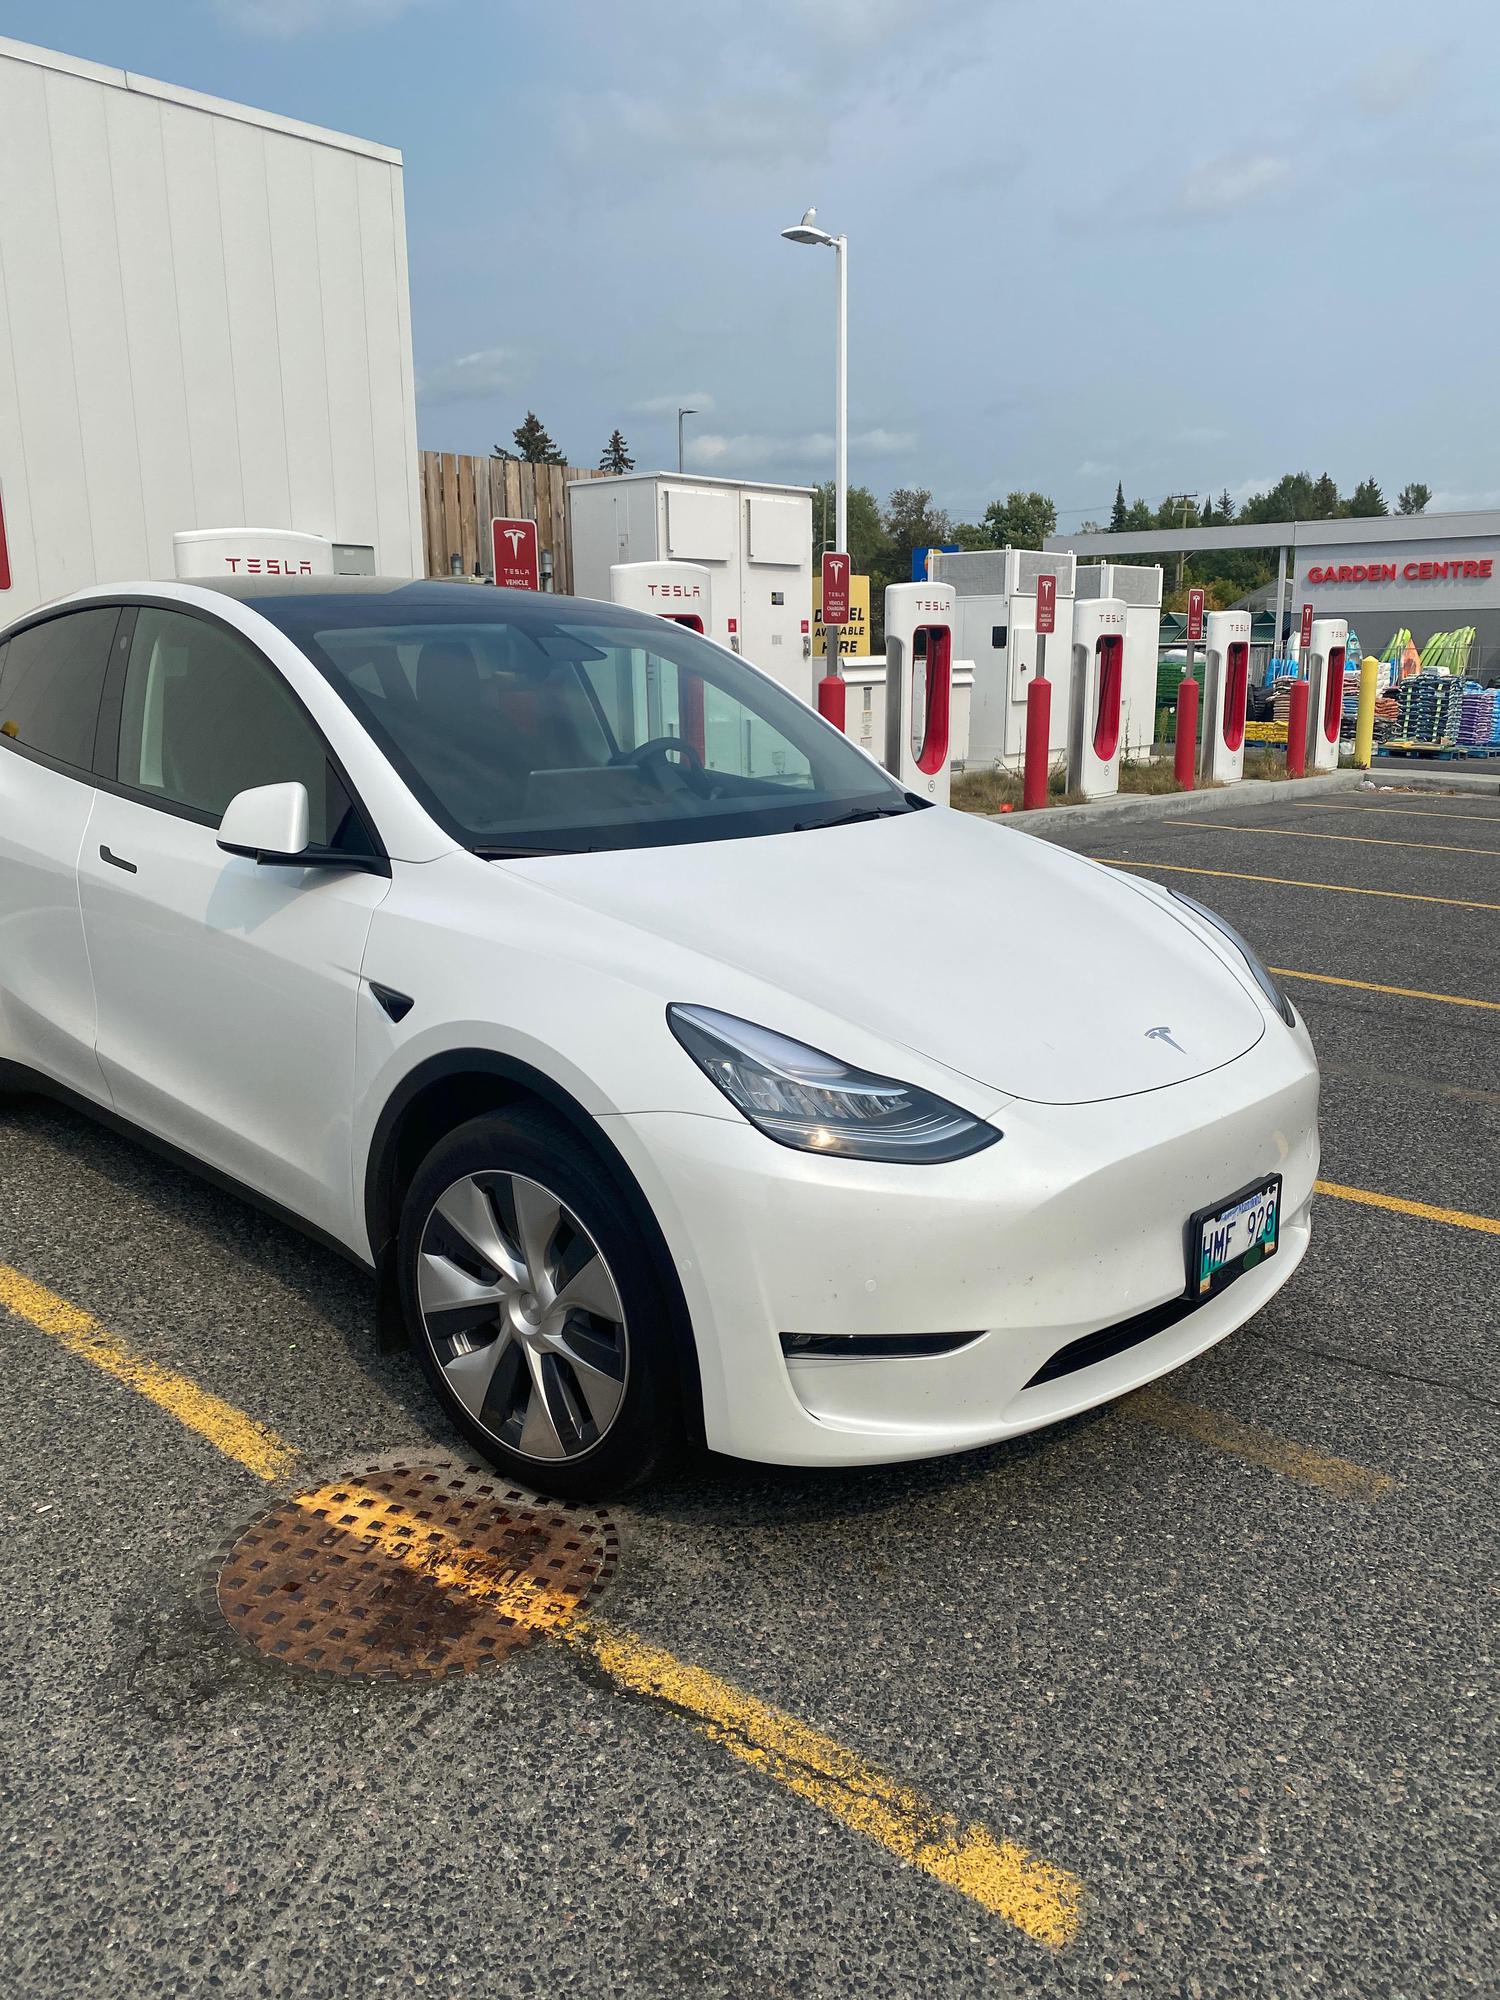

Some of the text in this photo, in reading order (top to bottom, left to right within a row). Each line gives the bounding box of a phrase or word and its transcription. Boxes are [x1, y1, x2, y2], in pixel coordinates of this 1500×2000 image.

[225, 558, 311, 575] TESLA
[1308, 560, 1493, 584] GARDEN CENTRE
[648, 584, 700, 597] TESLA
[916, 601, 950, 611] TESLA
[1099, 614, 1124, 623] TESLA
[1202, 1221, 1236, 1273] HMF
[1248, 1200, 1275, 1247] 928
